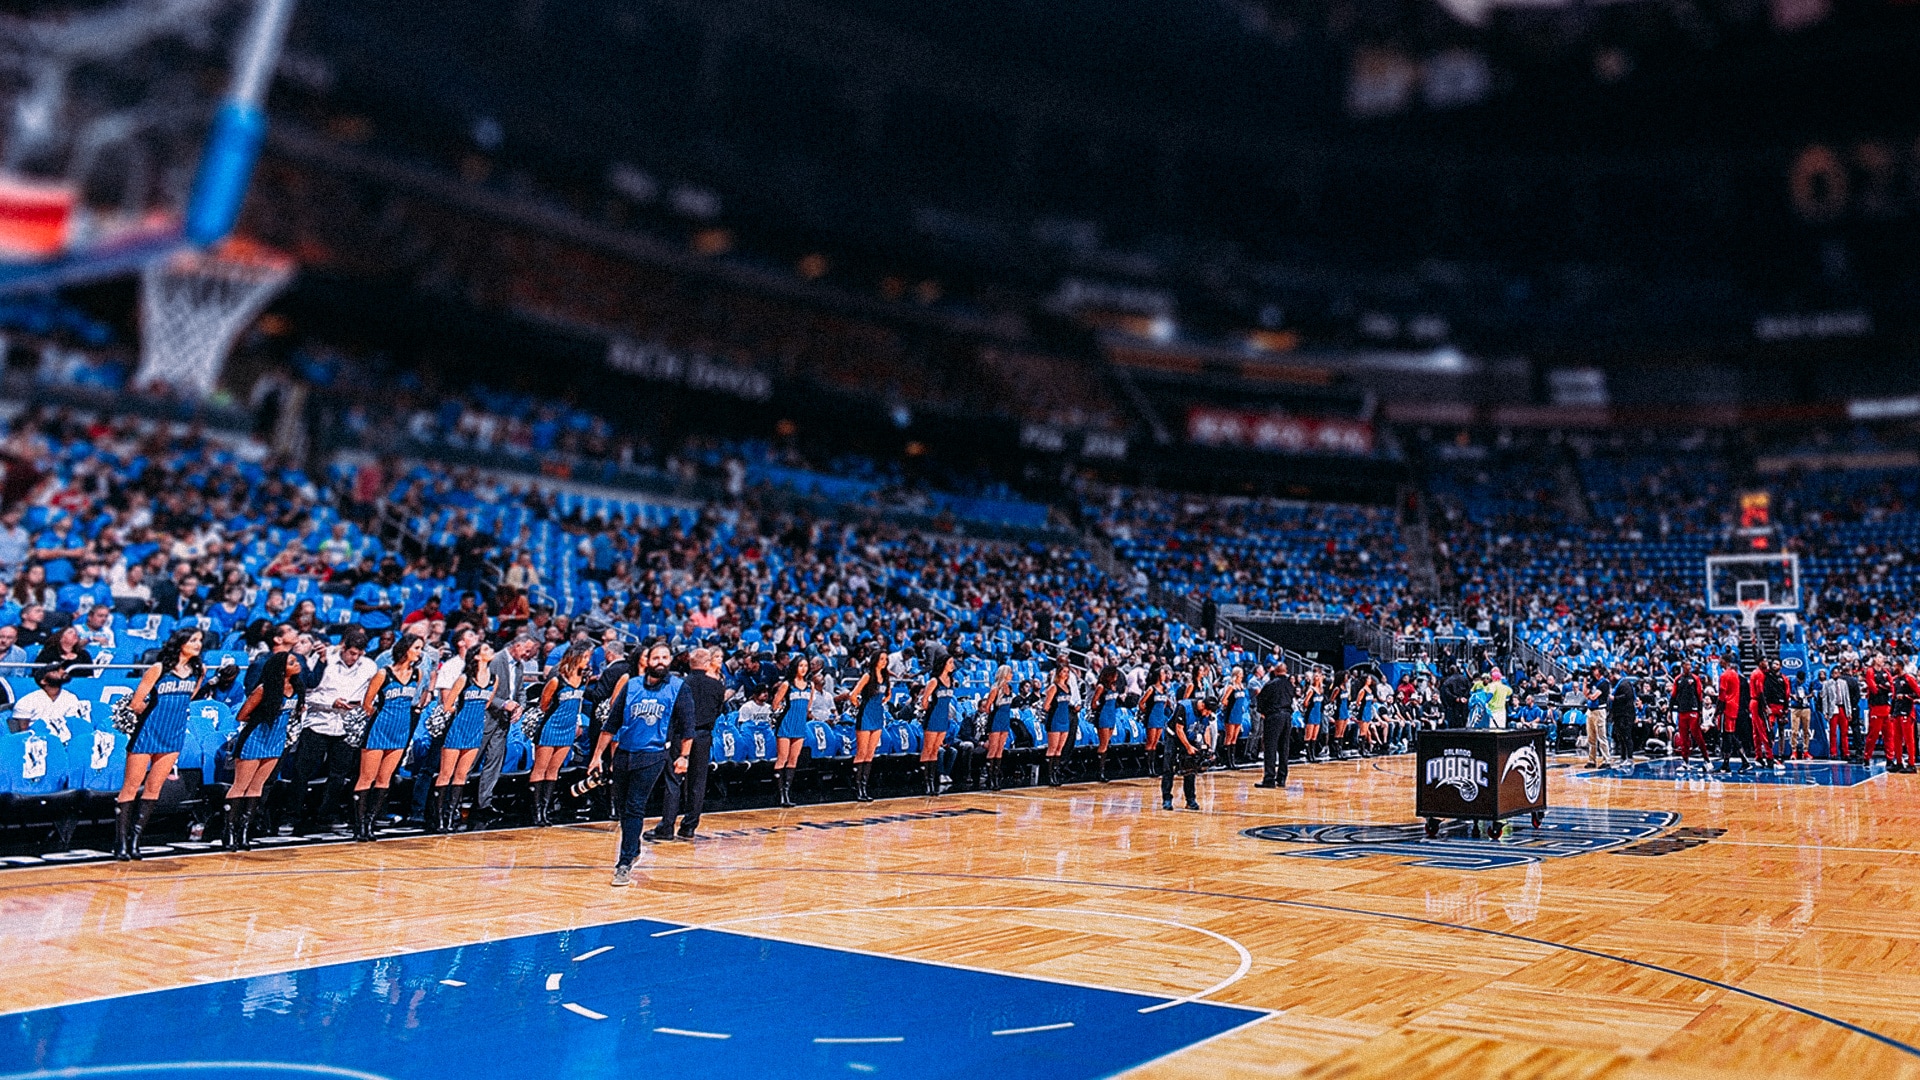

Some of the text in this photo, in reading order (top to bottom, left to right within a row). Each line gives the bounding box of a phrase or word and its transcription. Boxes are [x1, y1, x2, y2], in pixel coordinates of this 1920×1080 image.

[157, 680, 196, 694] ORLAN
[1443, 748, 1472, 757] ORLANDO
[1426, 757, 1488, 788] MAGIC
